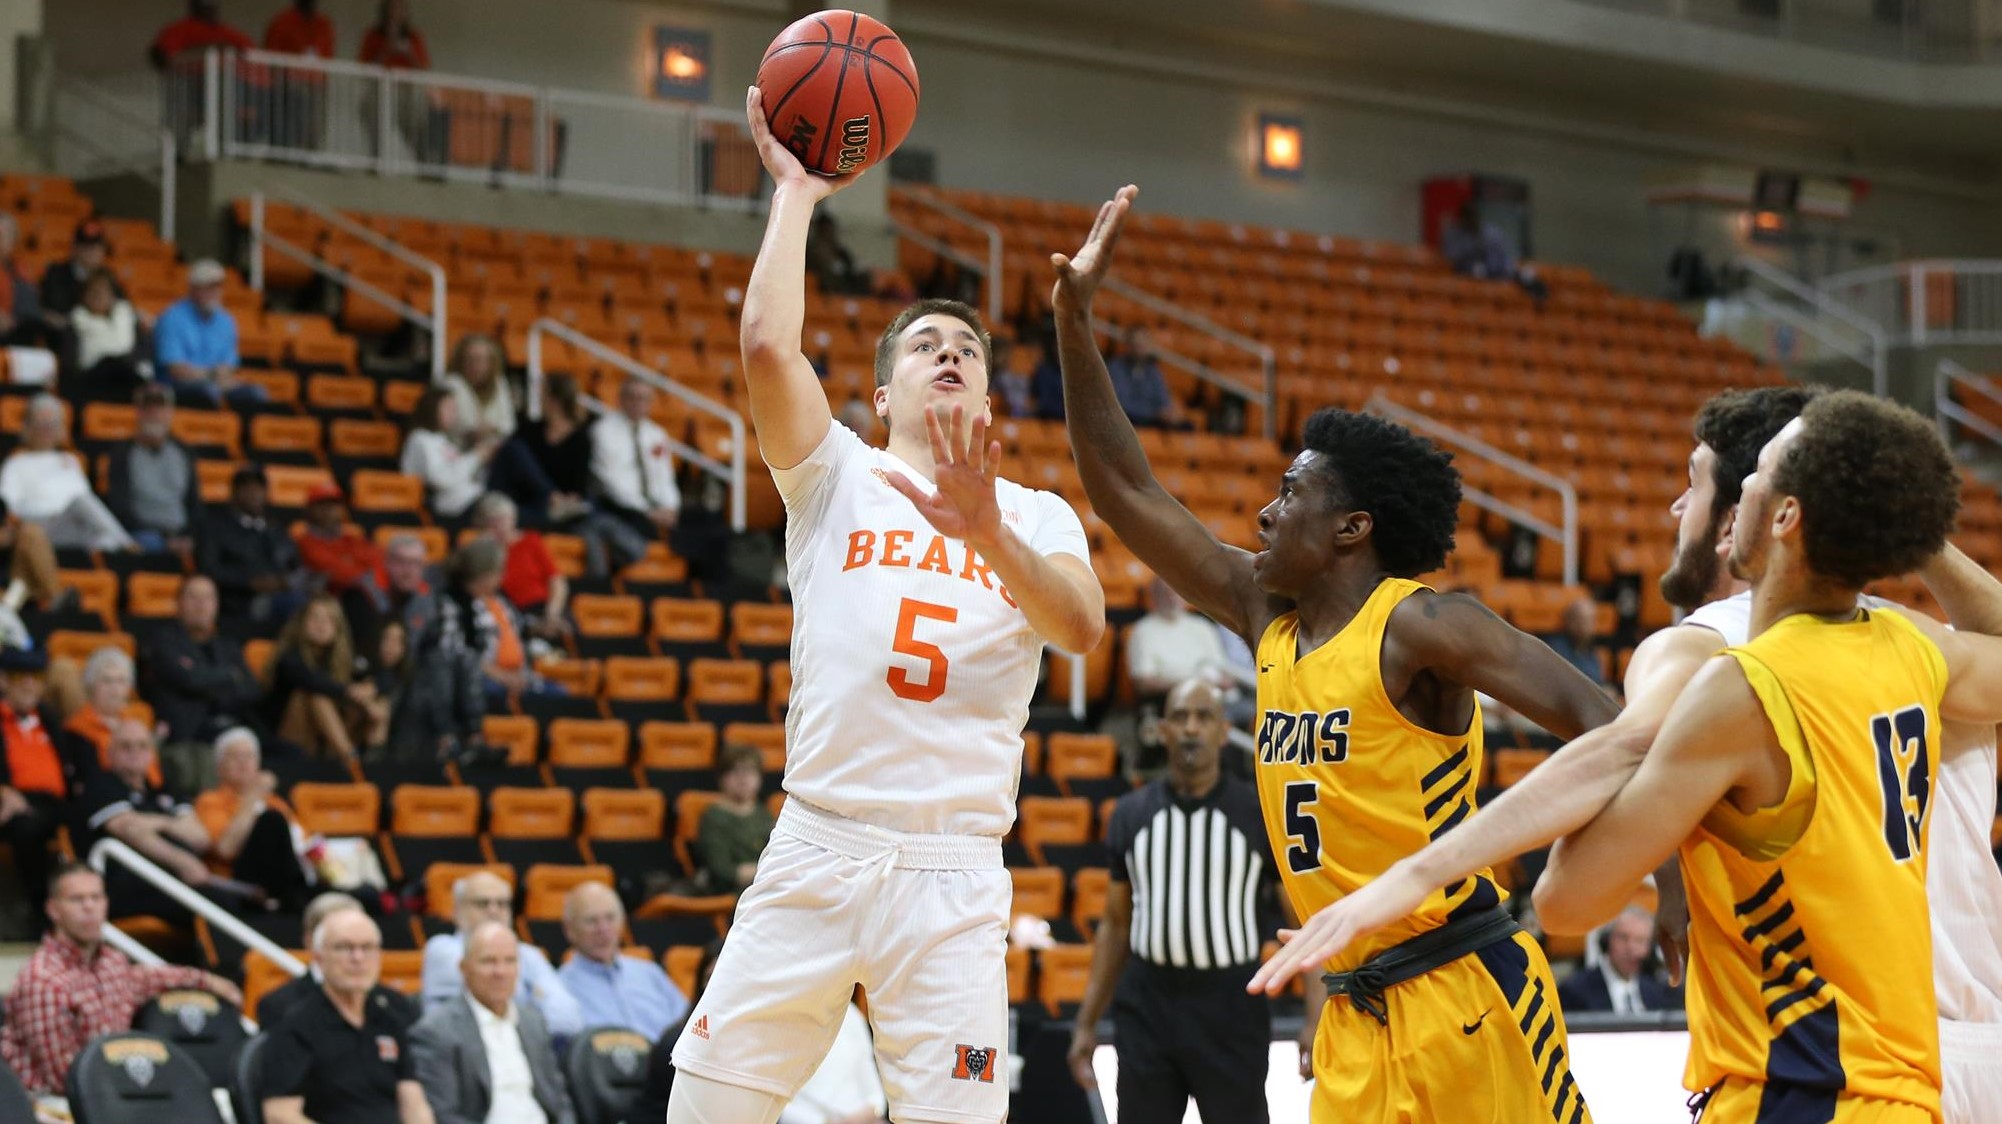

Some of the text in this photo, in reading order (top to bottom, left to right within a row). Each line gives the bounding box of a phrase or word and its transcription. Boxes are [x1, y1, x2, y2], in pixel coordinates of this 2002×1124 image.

[836, 114, 870, 175] Wils
[886, 596, 959, 703] 5
[1284, 780, 1324, 876] 5
[1869, 702, 1930, 865] 13
